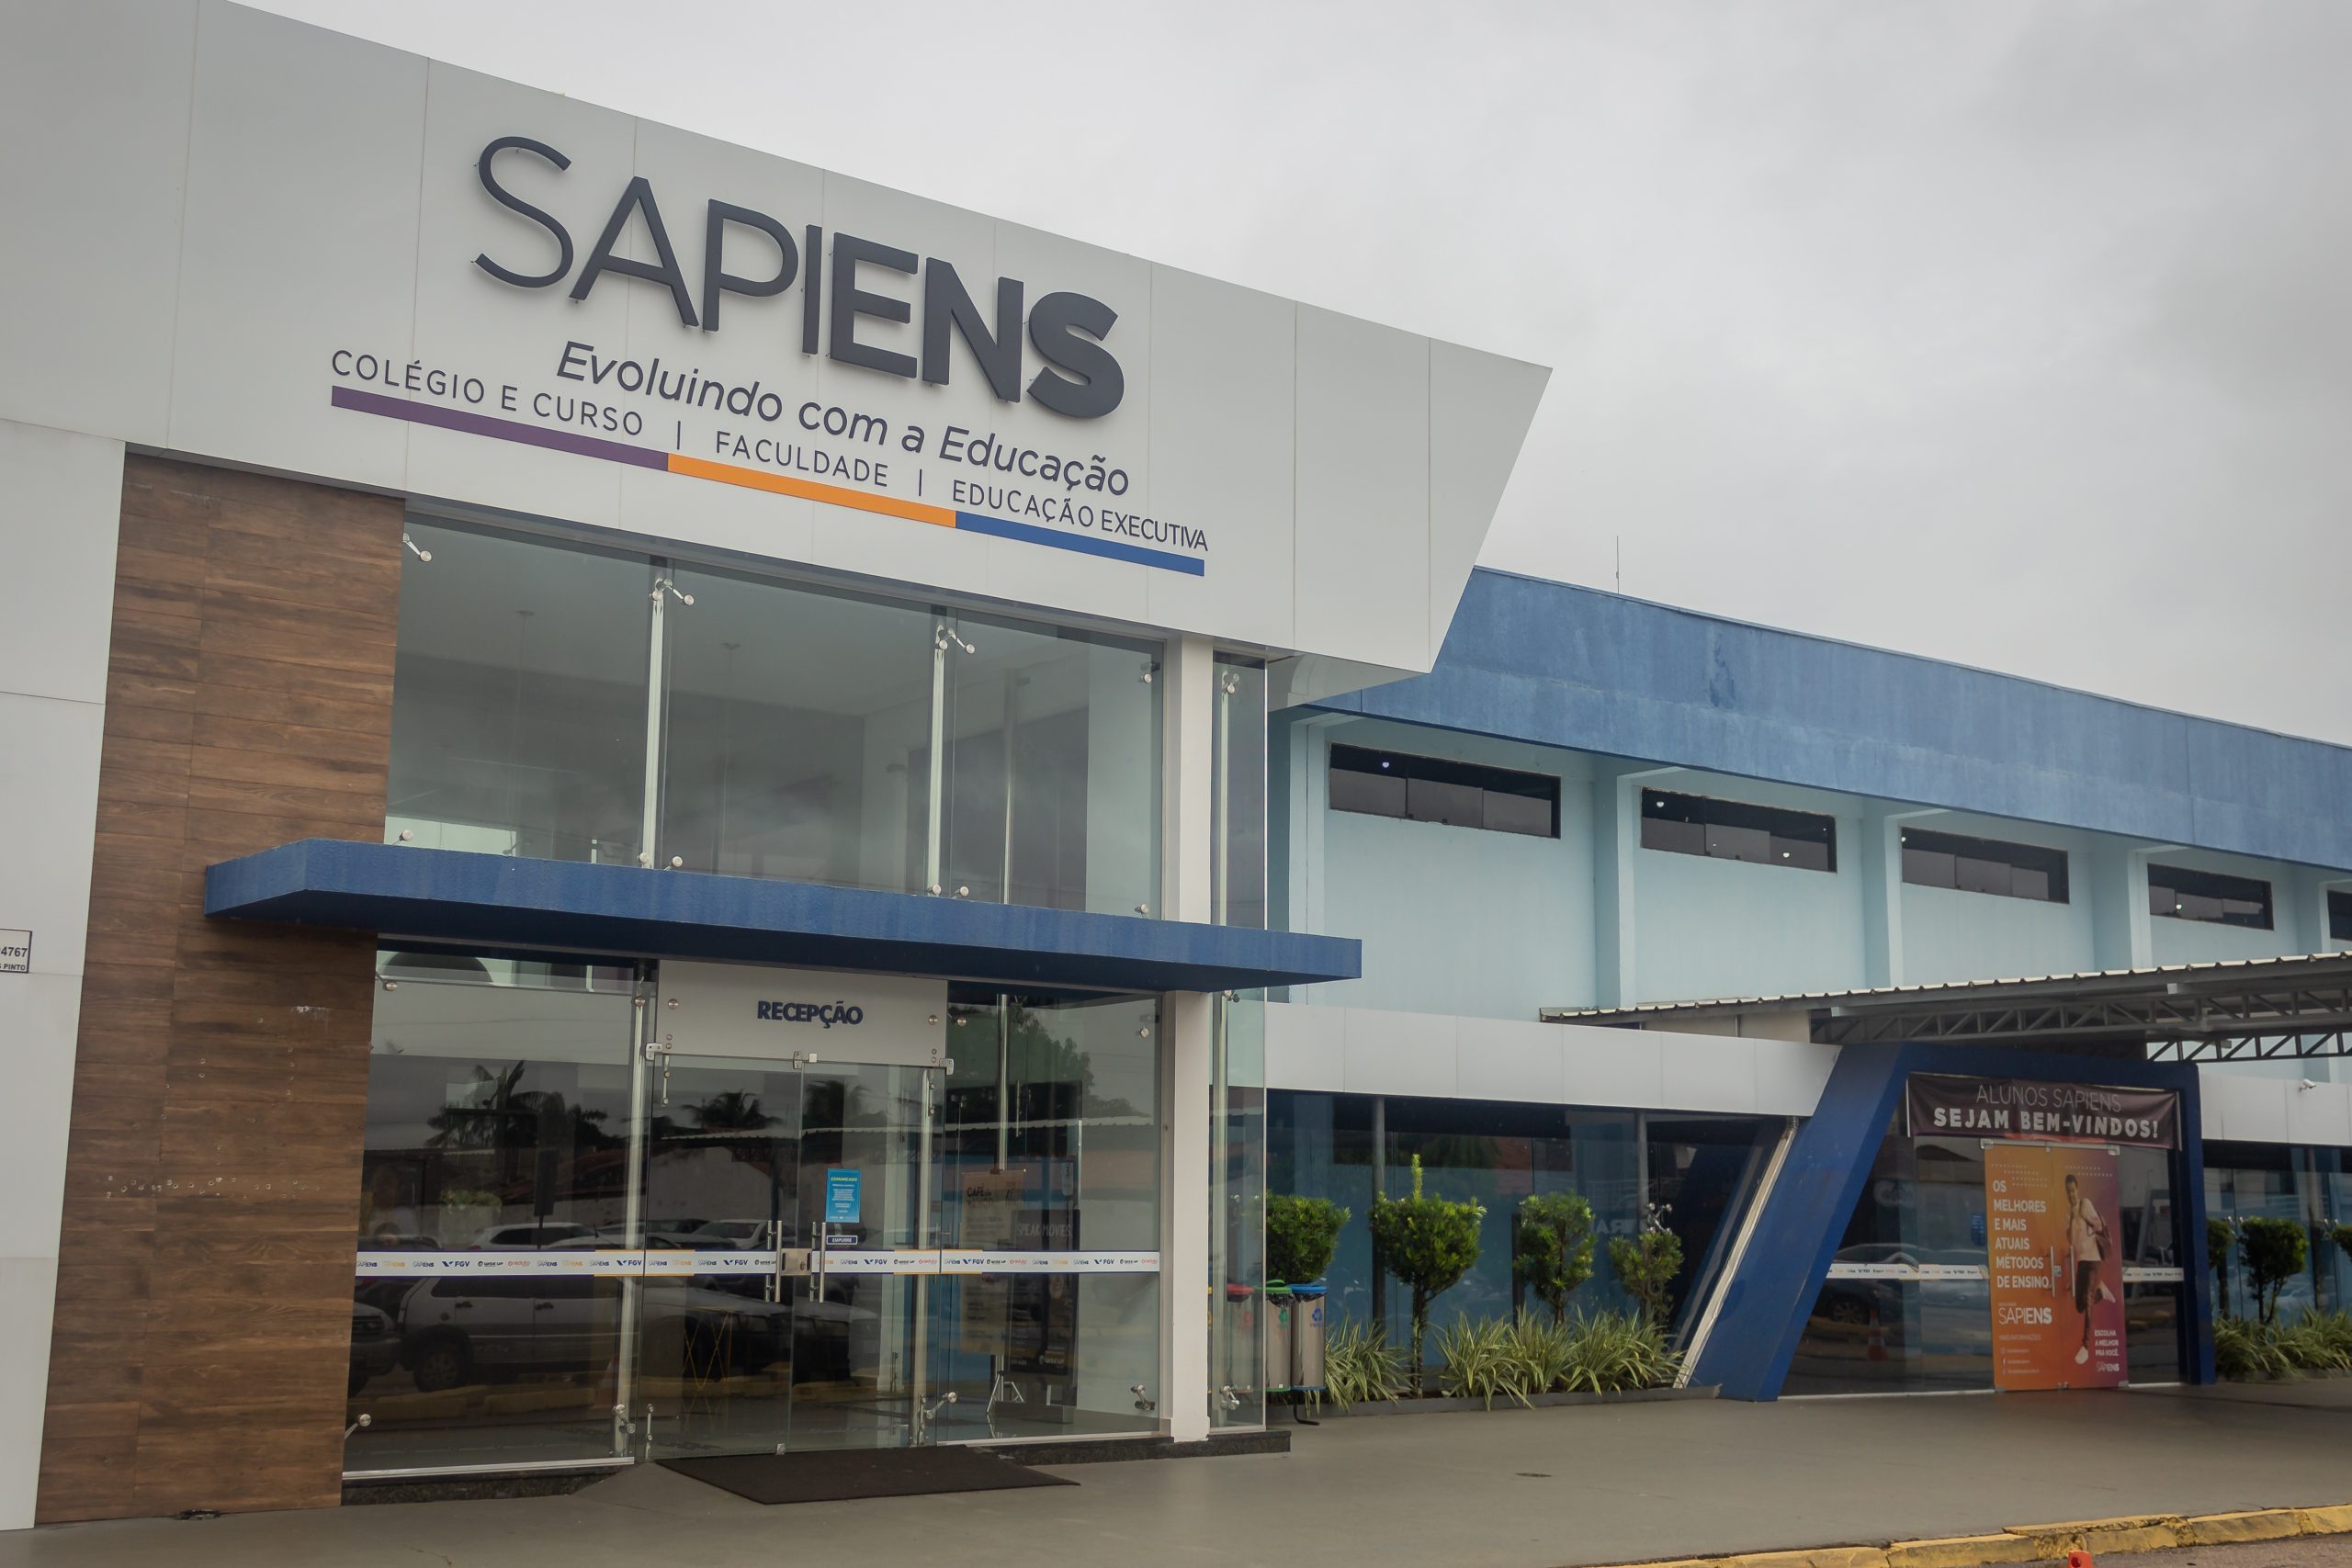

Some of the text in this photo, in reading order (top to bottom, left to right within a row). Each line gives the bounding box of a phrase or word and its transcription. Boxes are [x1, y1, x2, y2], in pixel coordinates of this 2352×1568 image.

[474, 136, 1125, 419] SAPIENS
[332, 350, 642, 435] COLÉGIO E CURSO
[557, 341, 1129, 496] Evoluindo com a Educação
[717, 431, 888, 487] FACULDADE
[953, 479, 1208, 551] EDUCAÇÃO EXECUTIVA
[0, 946, 28, 957] 4767
[757, 999, 864, 1029] RECEPÇÃO
[1976, 1084, 2121, 1112] ALUNOS SAPIENS
[1933, 1107, 2159, 1138] SEJAM BEM-VINDOS!
[1993, 1179, 2007, 1192] OS
[1994, 1199, 2046, 1213] MELHORES
[1994, 1218, 2001, 1231] E
[2003, 1218, 2027, 1231] MAIS
[1996, 1237, 2030, 1250] ATUAIS
[1996, 1253, 2044, 1269] MÉTODOS
[1996, 1275, 2010, 1288] DE
[1998, 1307, 2052, 1325] SAPIENS
